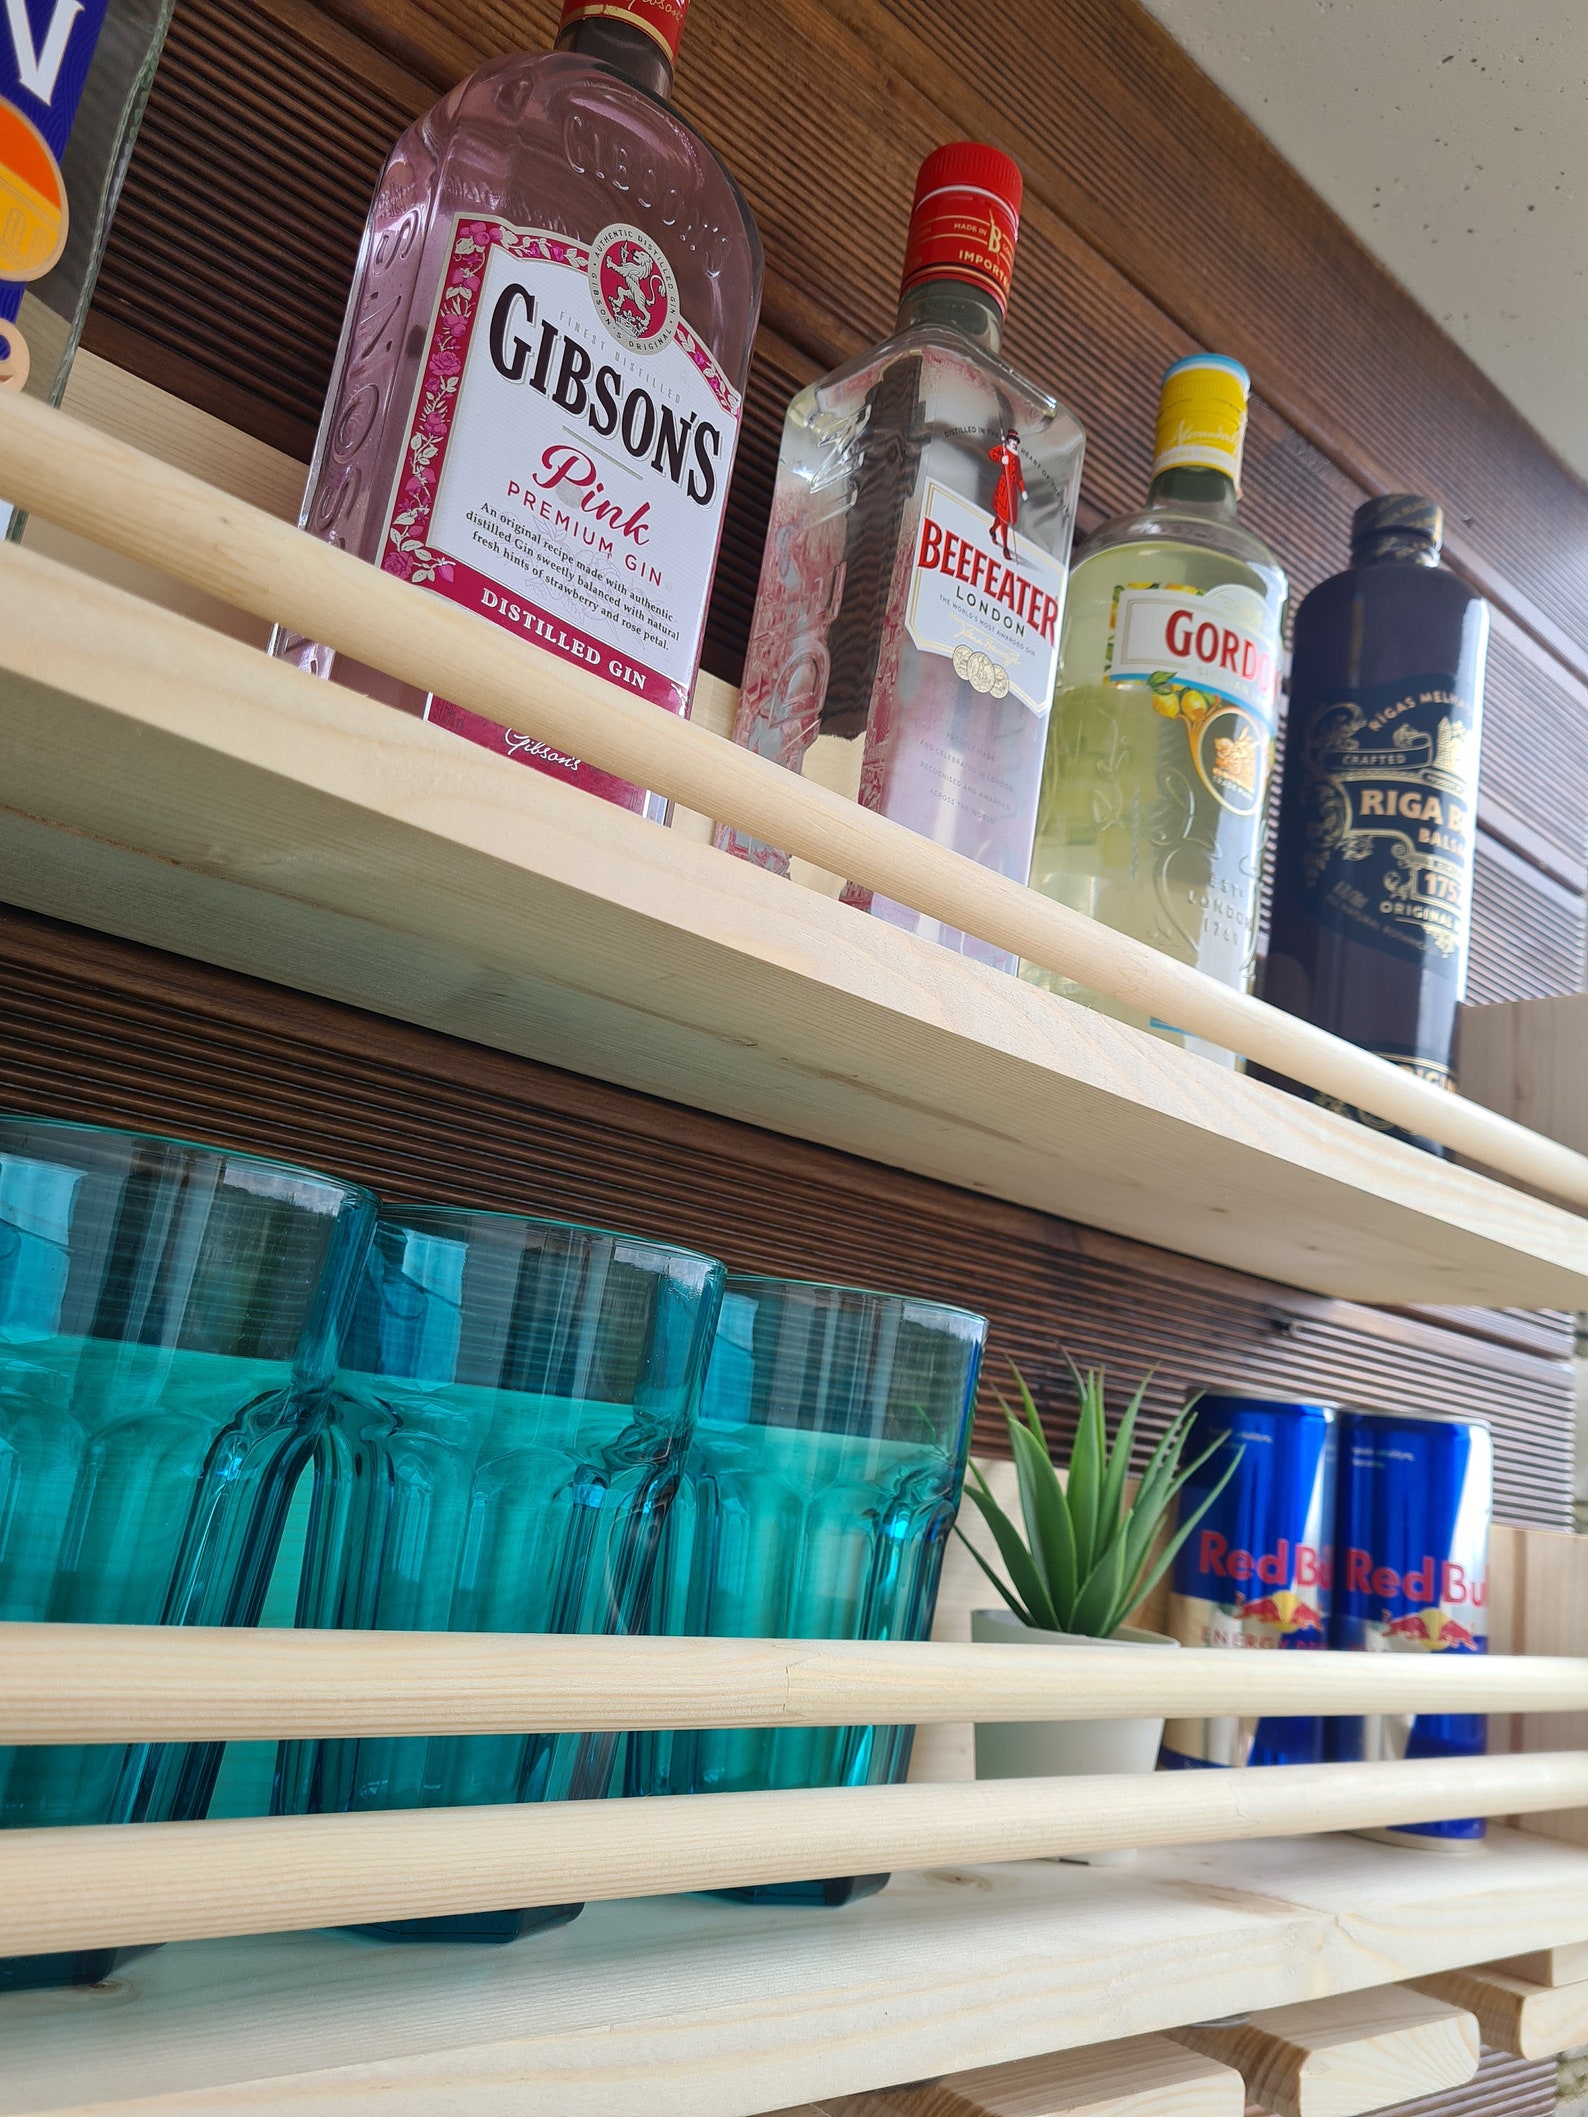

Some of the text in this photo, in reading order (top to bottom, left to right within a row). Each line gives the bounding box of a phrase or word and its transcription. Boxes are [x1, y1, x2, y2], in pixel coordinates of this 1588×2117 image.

[594, 229, 678, 315] AUTHENTIC DISTILLED GIN
[953, 222, 987, 236] MADE IN
[959, 249, 1010, 294] IMPORTE
[560, 310, 681, 405] FINEST DISTILLED
[628, 328, 672, 351] ORIGINAL
[489, 282, 722, 506] GIBSON'S
[944, 426, 977, 438] DISTILLED
[506, 480, 662, 587] PREMIUM GIN
[532, 444, 652, 546] Pink
[466, 511, 680, 641] distilled Gin sweetly balanced with natural
[472, 530, 669, 650] fresh hints of strawberry and rose petal.
[480, 502, 674, 622] An original recipe made with authentic
[917, 517, 1059, 647] BEEFEATER
[481, 587, 647, 690] DISTILLED GIN
[939, 594, 950, 606] THE
[979, 619, 995, 633] MOST
[956, 585, 1025, 637] LONDON
[1165, 609, 1279, 700] GORDO
[1341, 754, 1407, 766] CRAFTED
[1360, 789, 1443, 826] RIGA
[1199, 1530, 1289, 1586] Red
[1347, 1547, 1490, 1608] Red Bu
